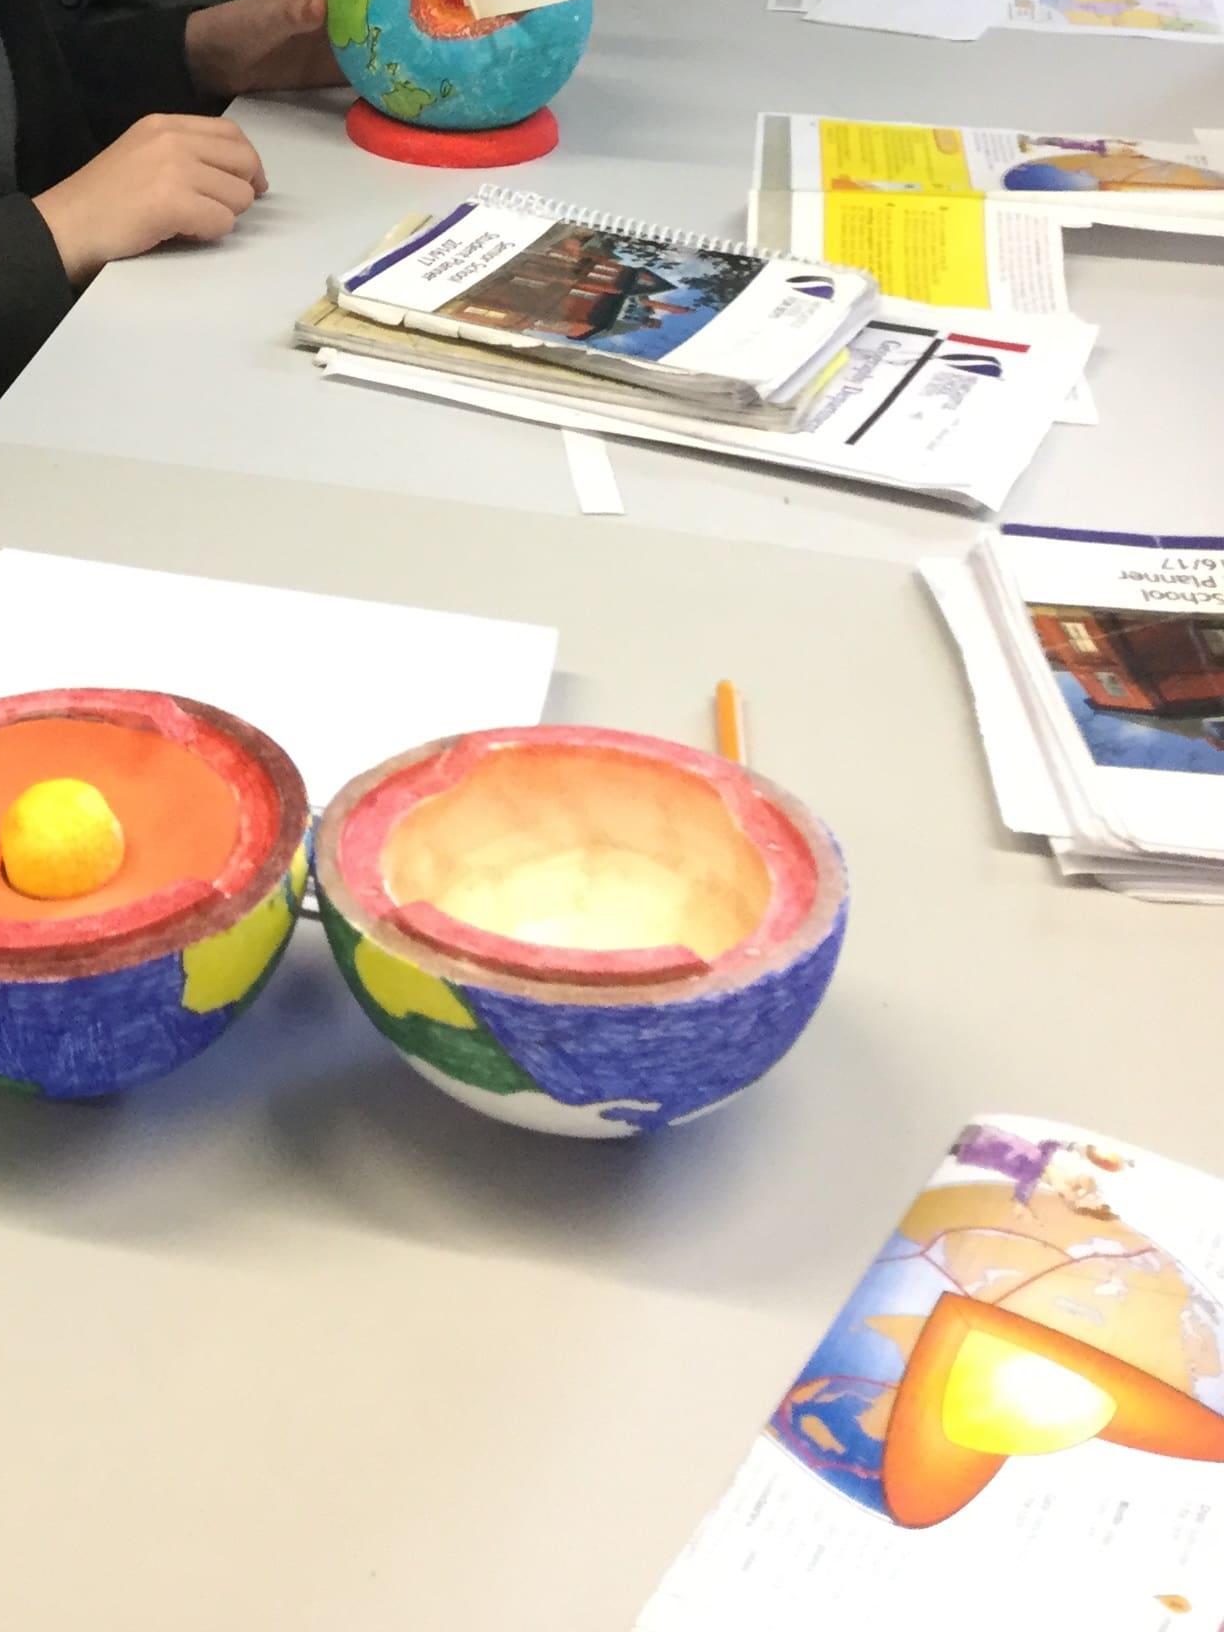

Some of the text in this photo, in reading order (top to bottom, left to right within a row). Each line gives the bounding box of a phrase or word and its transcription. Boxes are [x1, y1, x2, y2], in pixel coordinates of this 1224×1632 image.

[421, 256, 466, 281] Planner
[448, 262, 488, 284] School
[1118, 570, 1217, 588] Planner
[1141, 589, 1224, 606] School
